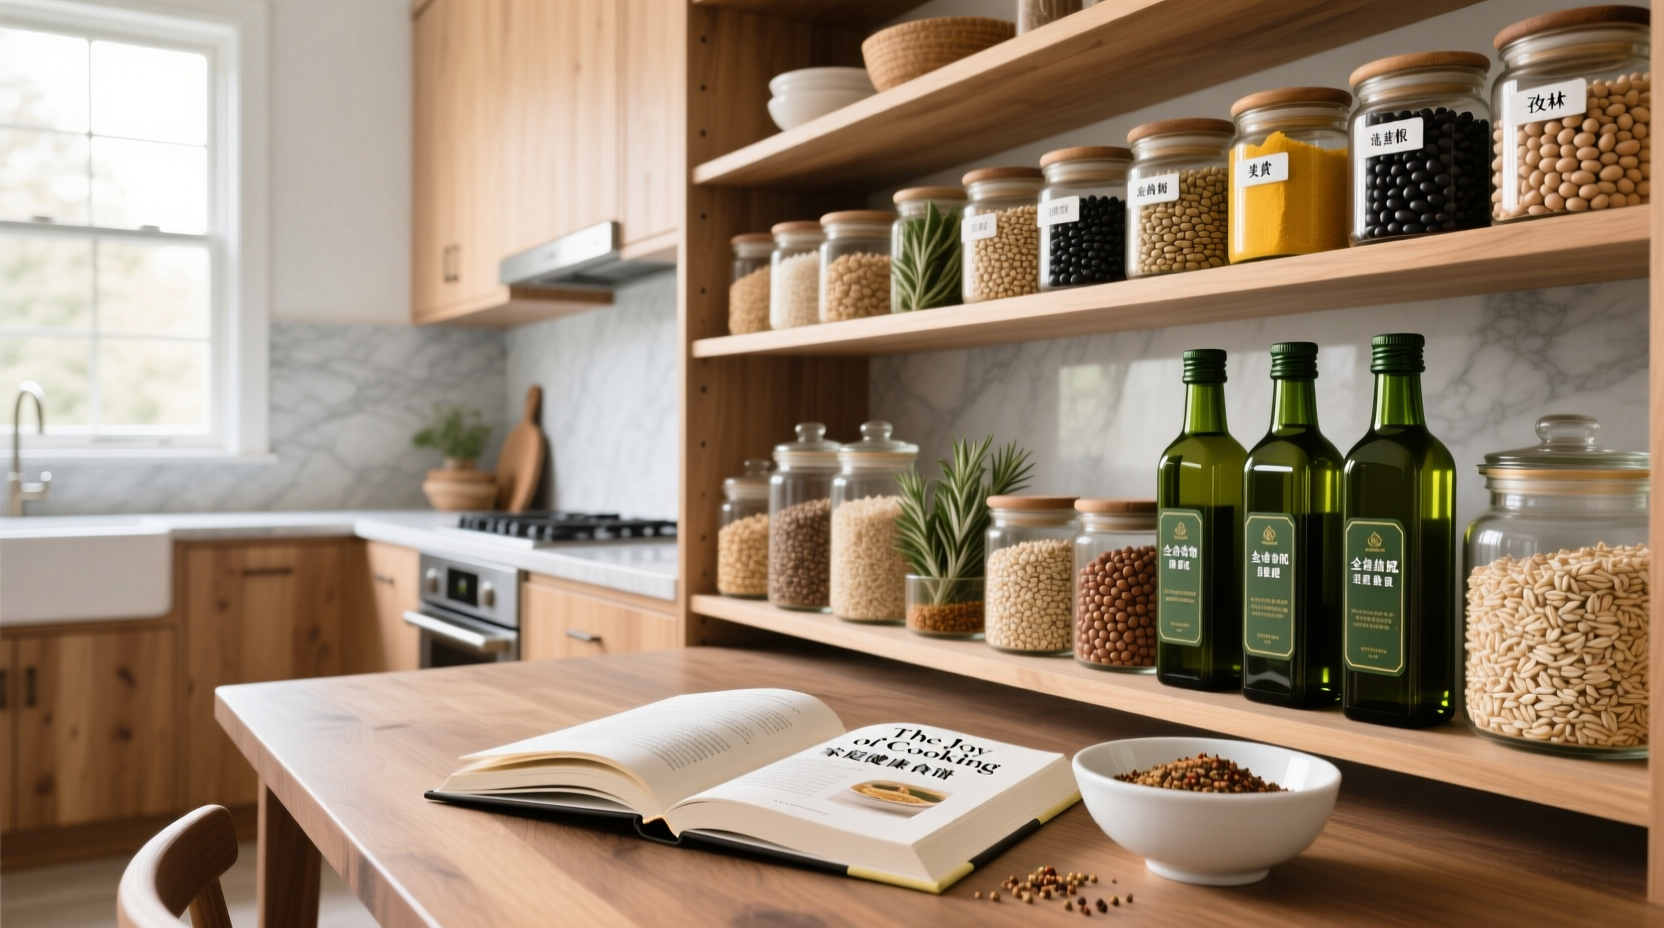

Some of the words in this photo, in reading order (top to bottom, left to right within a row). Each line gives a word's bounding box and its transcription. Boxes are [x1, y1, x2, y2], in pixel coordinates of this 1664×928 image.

[853, 737, 888, 747] of
[887, 740, 1001, 776] Cooking
[894, 727, 941, 745] The
[943, 738, 993, 758] Joy
